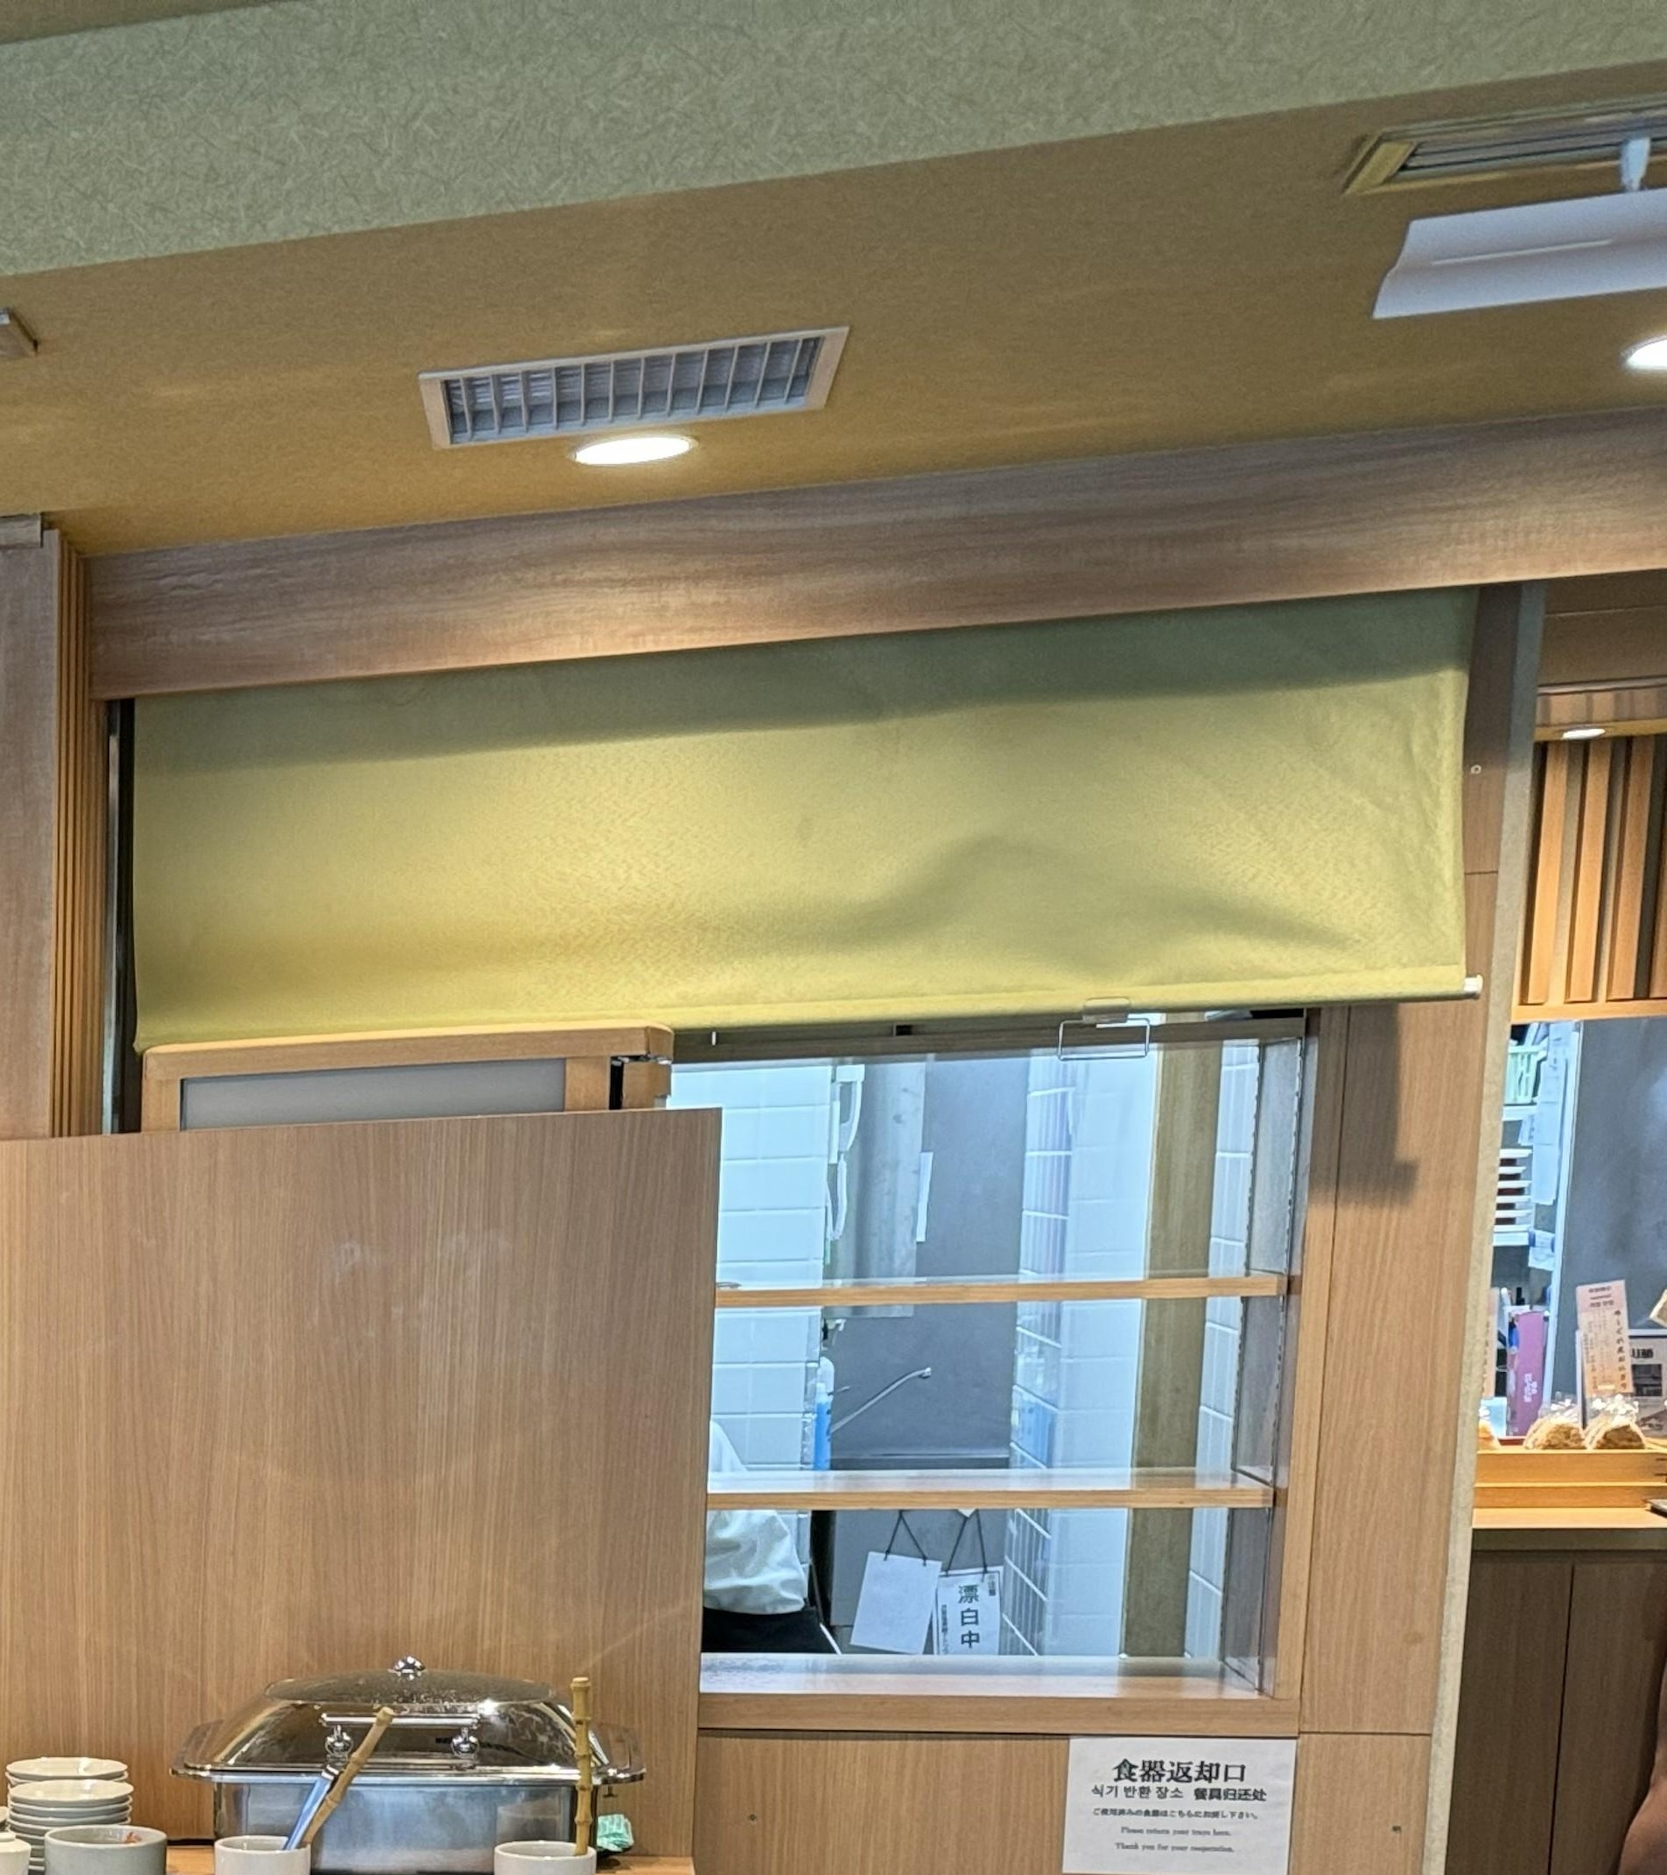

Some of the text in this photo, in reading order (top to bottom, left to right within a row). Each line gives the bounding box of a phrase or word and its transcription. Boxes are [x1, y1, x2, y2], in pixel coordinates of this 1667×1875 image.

[958, 1584, 980, 1649] 漂白中
[1112, 1758, 1247, 1784] 食器返却口
[1091, 1784, 1184, 1800] 식기 반환 장소
